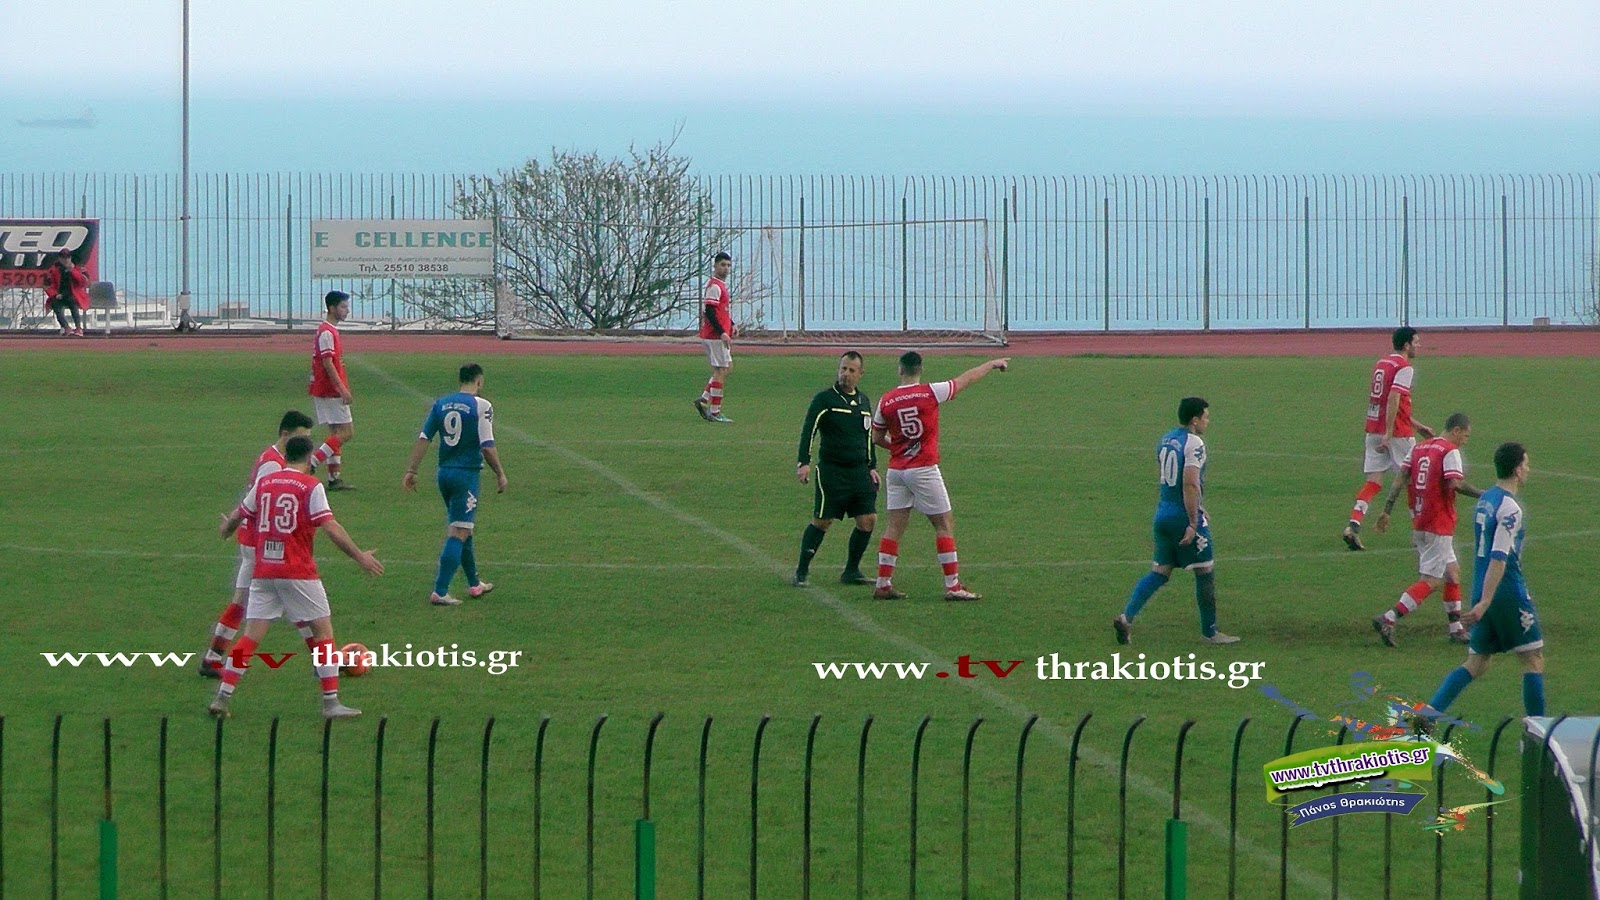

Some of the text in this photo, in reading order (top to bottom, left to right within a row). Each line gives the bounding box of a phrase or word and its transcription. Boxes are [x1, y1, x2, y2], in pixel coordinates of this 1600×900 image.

[315, 232, 492, 248] E CELLENCE
[384, 264, 414, 272] 25510
[418, 264, 448, 272] 38538
[443, 411, 462, 447] 9
[897, 406, 923, 439] 5
[1159, 447, 1178, 487] 10
[1415, 456, 1431, 489] 6
[259, 492, 299, 534] 13
